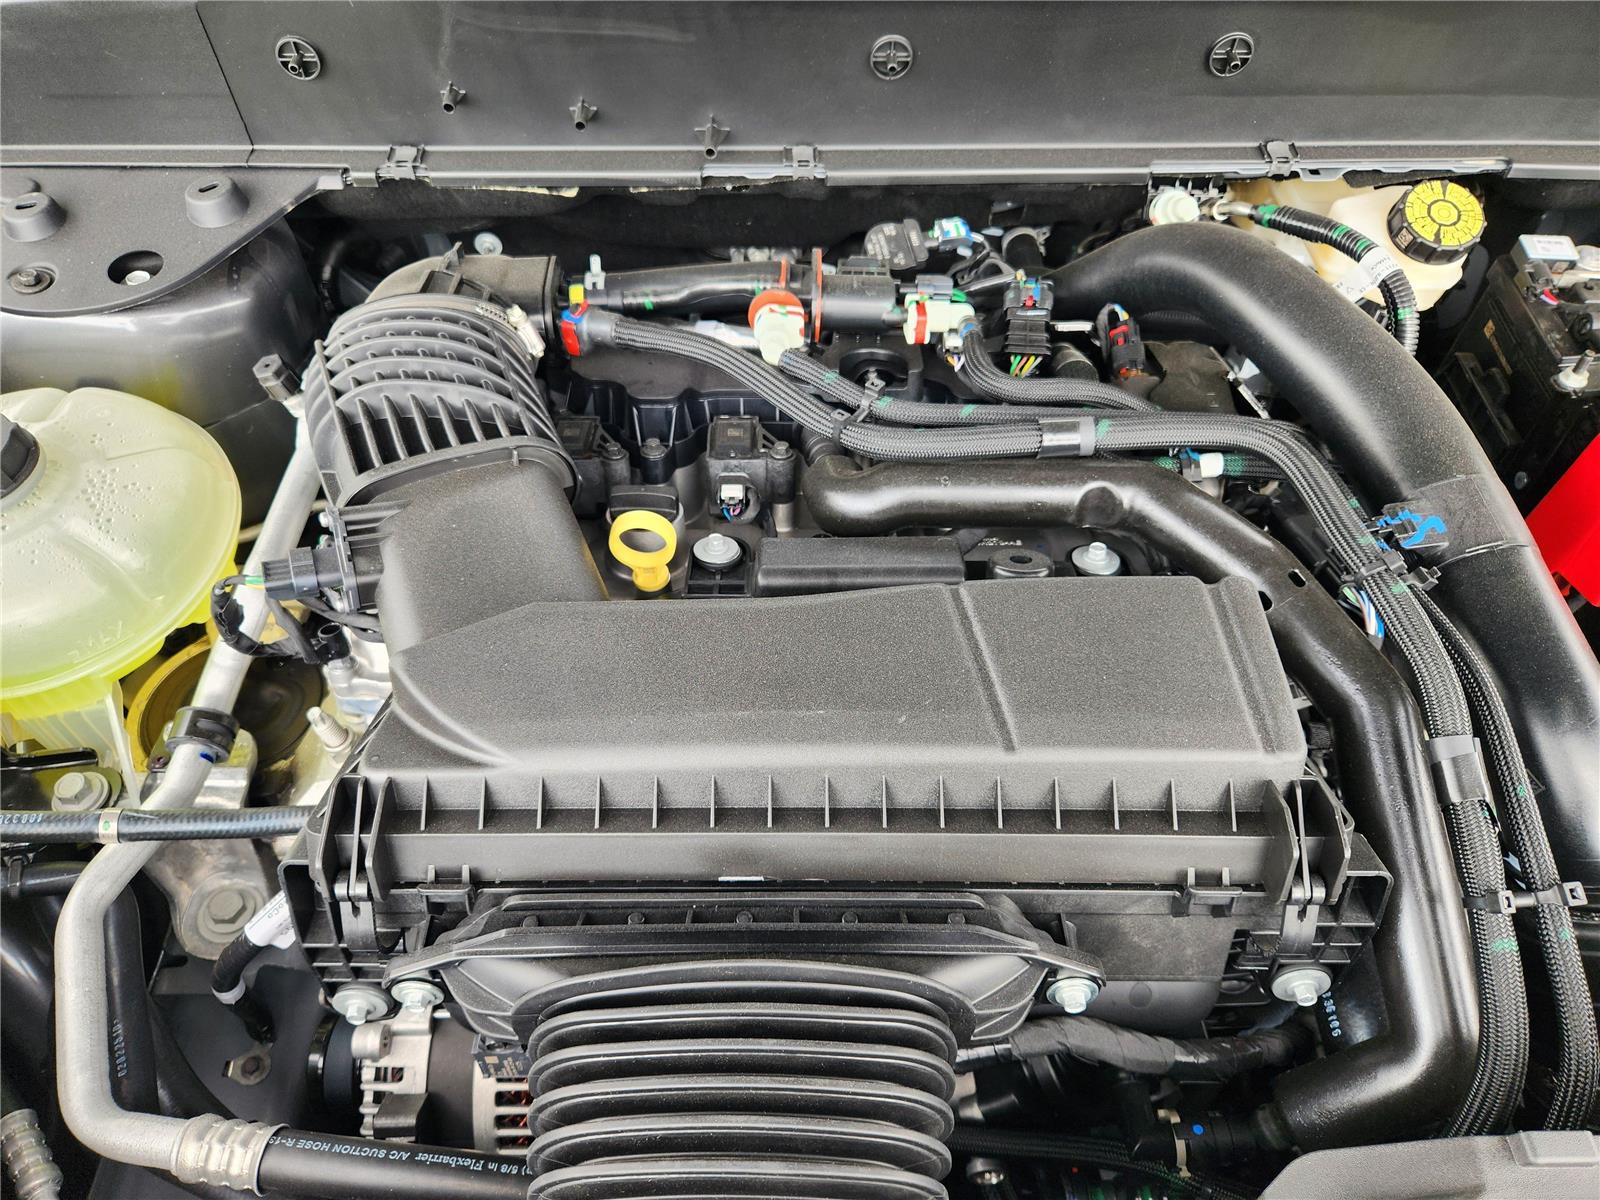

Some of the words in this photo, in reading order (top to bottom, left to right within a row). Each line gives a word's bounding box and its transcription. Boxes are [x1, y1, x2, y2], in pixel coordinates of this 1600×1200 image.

[296, 1139, 331, 1152] HOSE
[332, 1144, 387, 1159] SUCTION
[388, 1149, 411, 1161] A/C
[415, 1152, 485, 1171] Flexbarrier
[500, 1163, 518, 1175] 5/8
